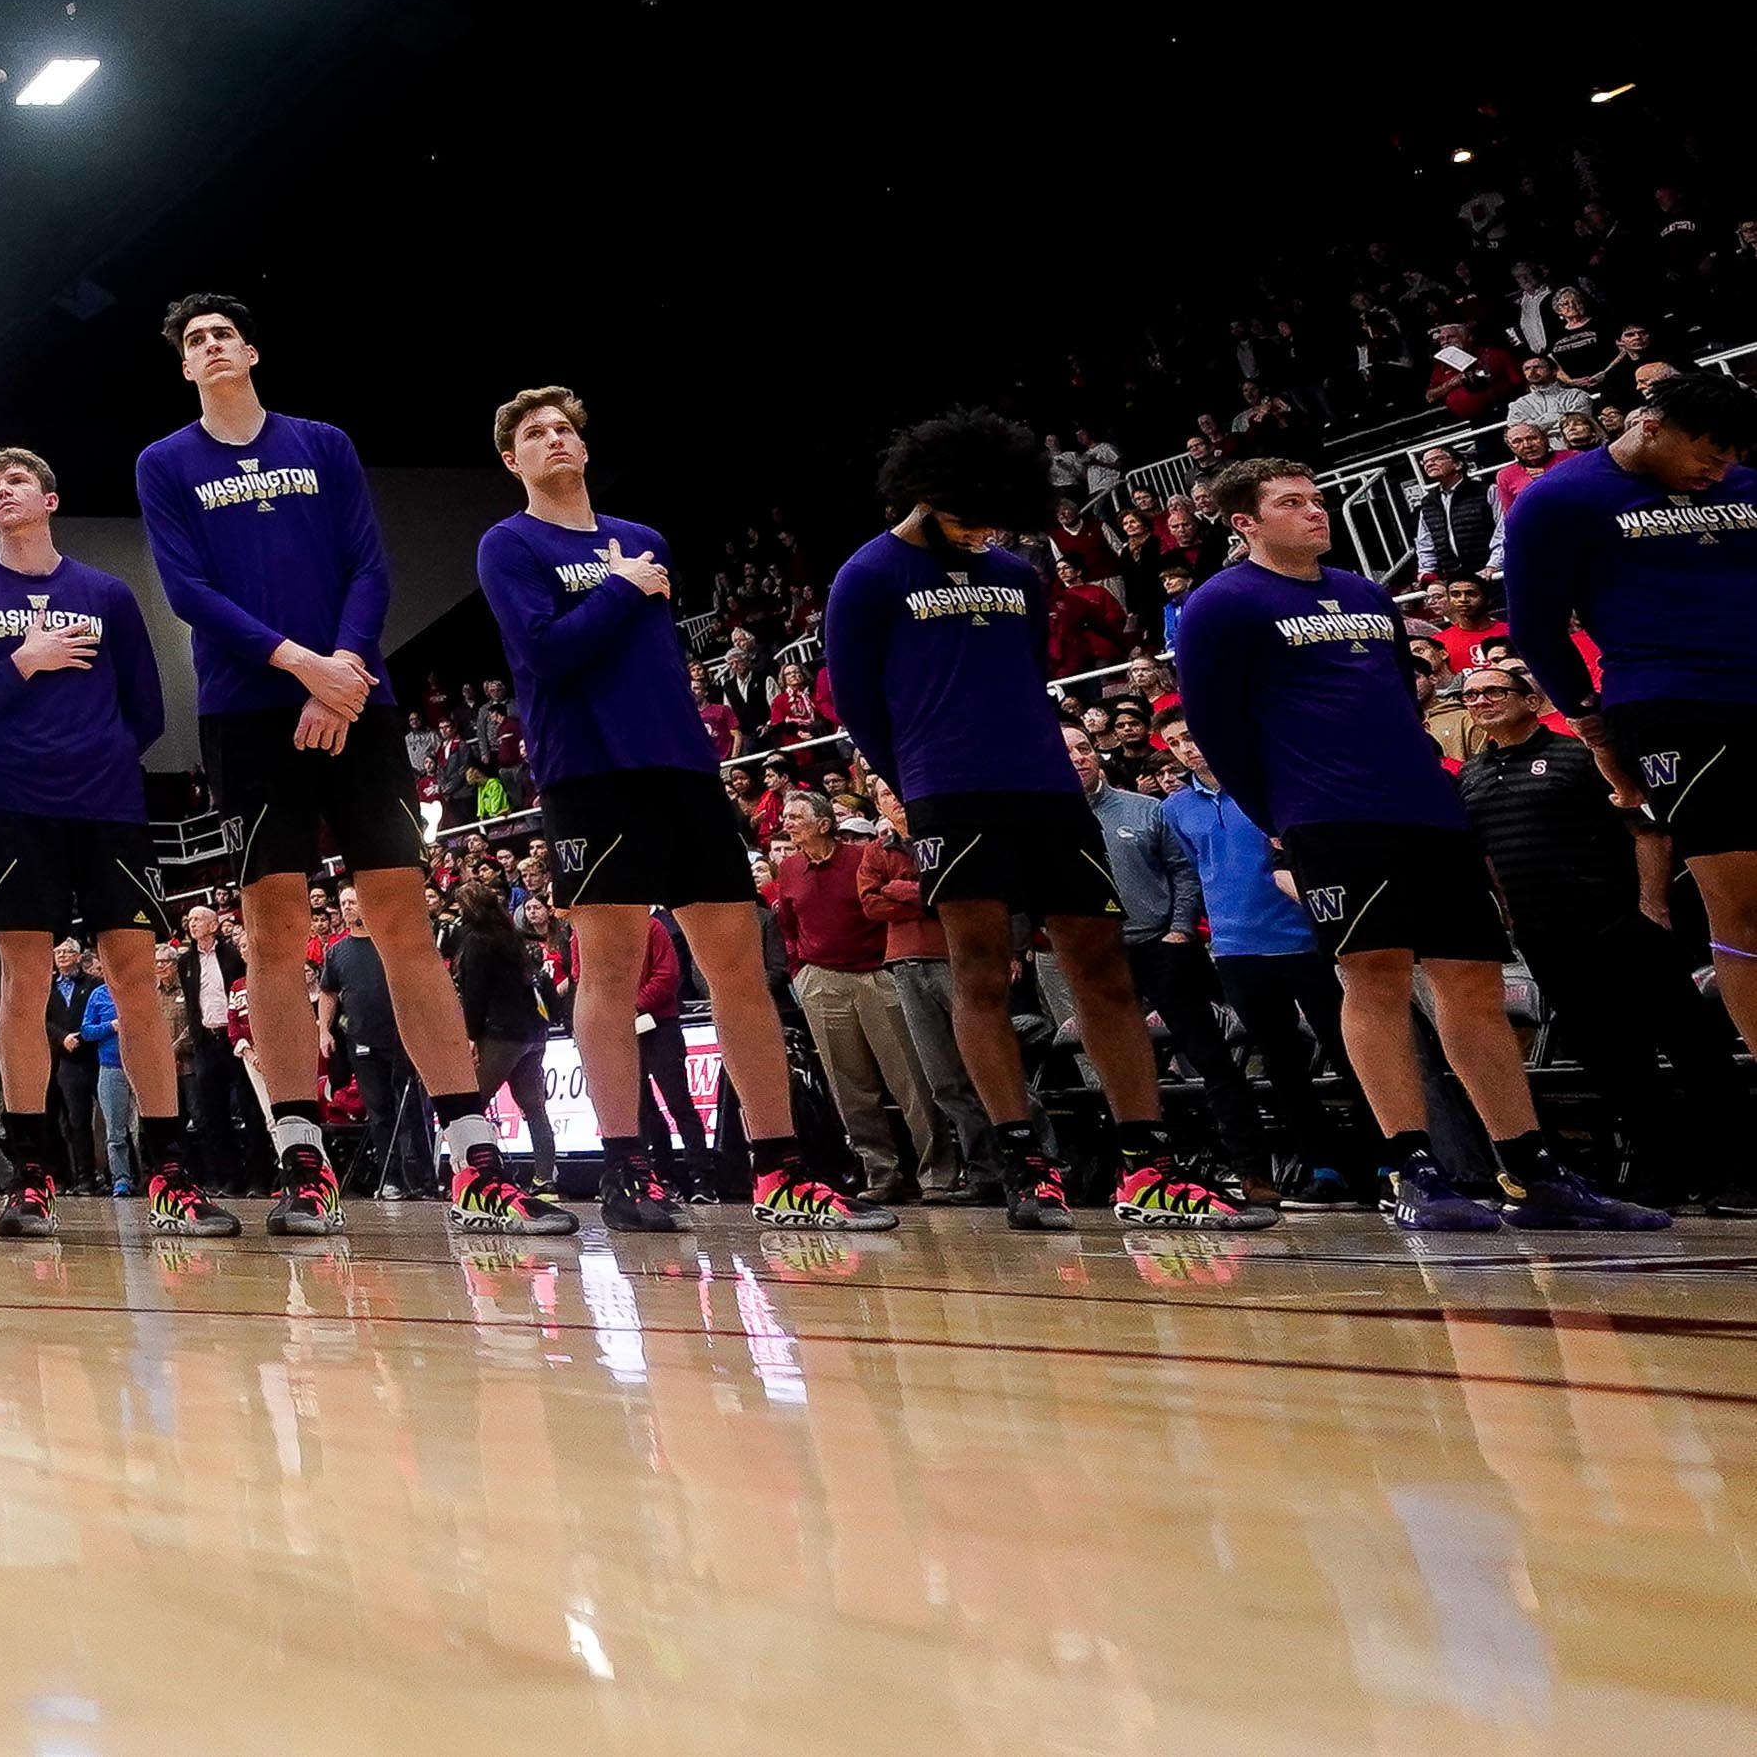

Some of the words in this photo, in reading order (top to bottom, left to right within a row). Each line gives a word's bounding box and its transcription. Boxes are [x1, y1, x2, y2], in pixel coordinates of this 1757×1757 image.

[194, 468, 319, 502] WASHINGTON
[906, 586, 1026, 611] WASHINGTON
[1639, 751, 1681, 788] W
[555, 838, 588, 873] W
[1306, 885, 1347, 923] W
